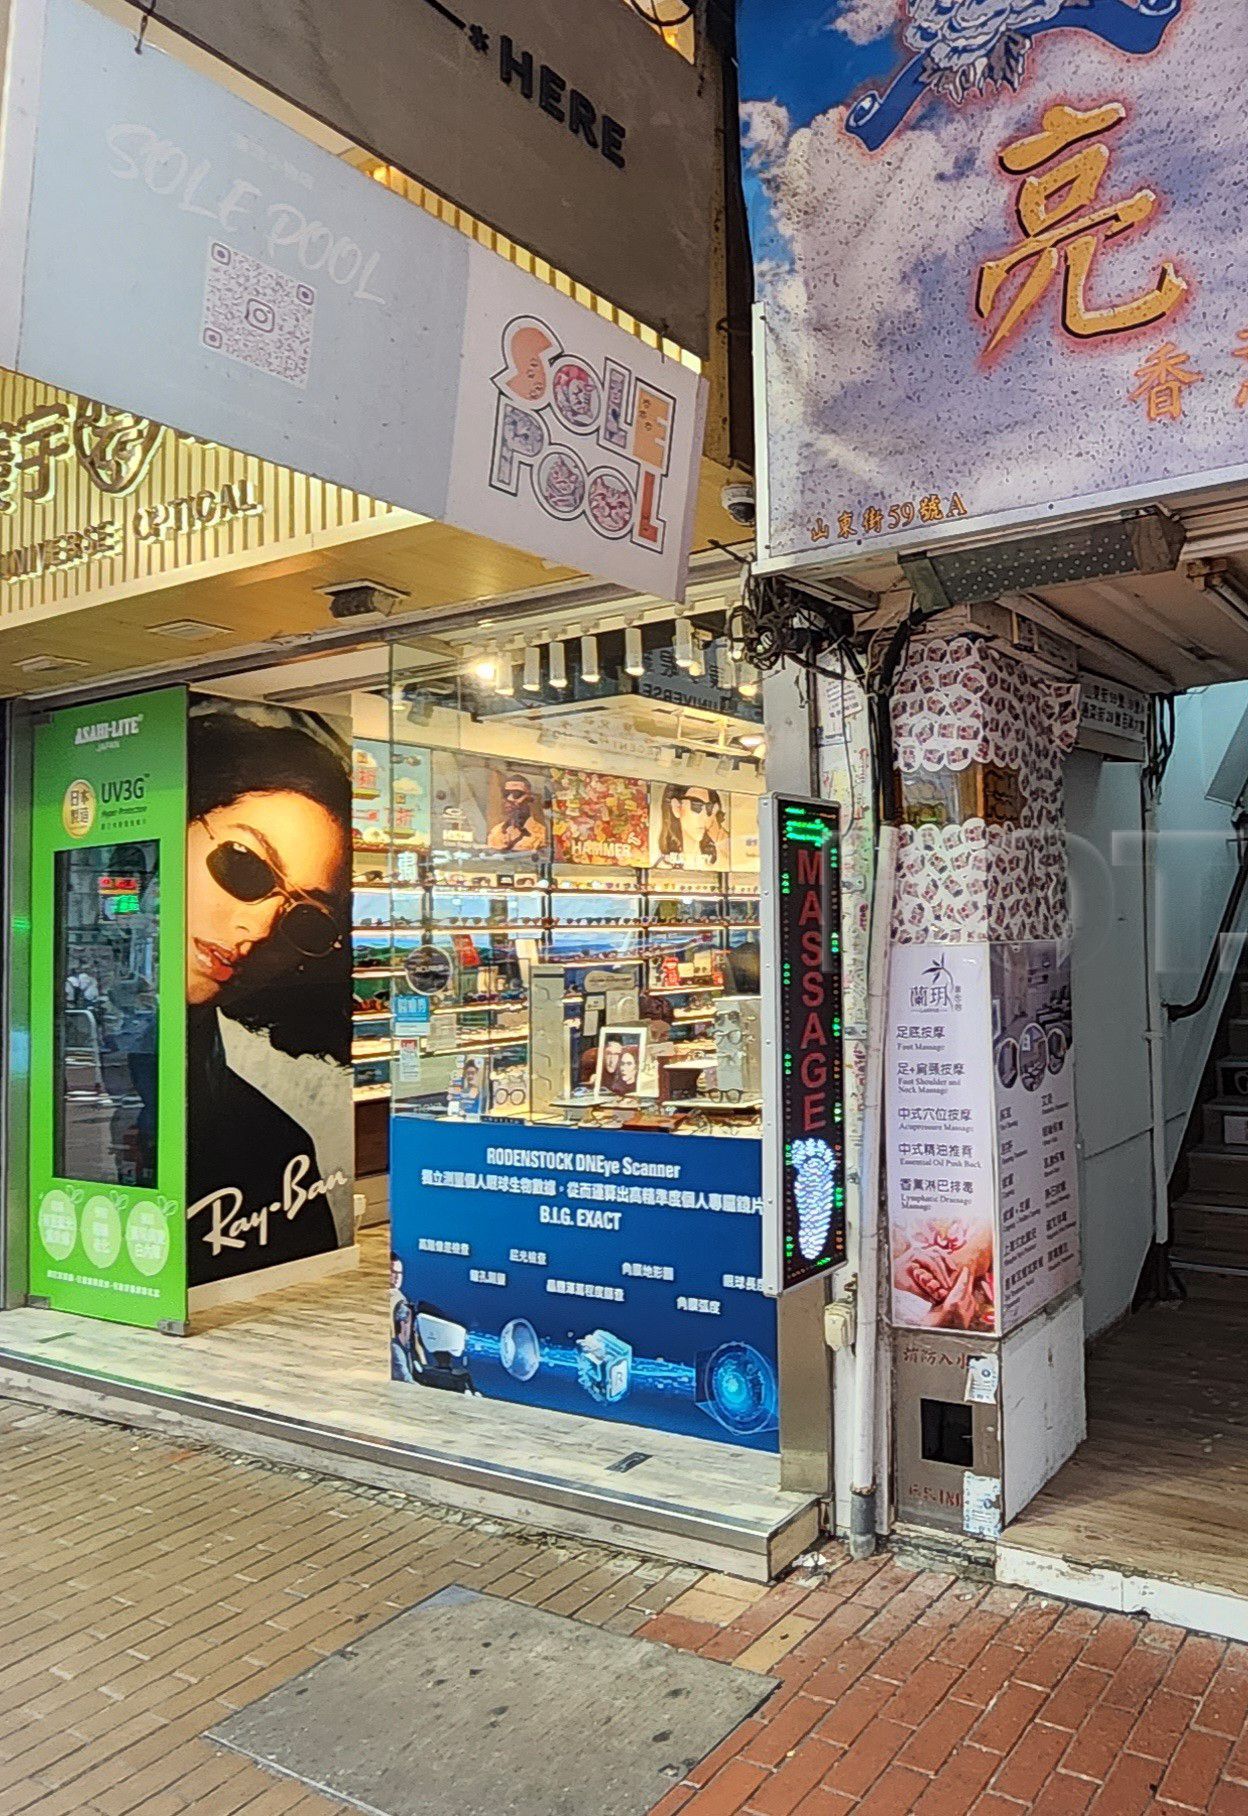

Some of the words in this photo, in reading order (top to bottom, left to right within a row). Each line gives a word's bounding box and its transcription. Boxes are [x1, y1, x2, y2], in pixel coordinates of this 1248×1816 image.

[499, 36, 628, 168] HERE
[107, 123, 262, 234] SOLE
[267, 203, 387, 305] POOL
[490, 314, 677, 478] SOLE
[133, 478, 261, 543] OPTICAL
[489, 393, 666, 554] POOL
[101, 777, 145, 804] UV3G
[797, 848, 826, 1132] MASSAGE
[486, 1147, 573, 1171] RODENSTOCK
[622, 1156, 681, 1178] Scanner
[540, 1205, 575, 1227] B.I.G.
[576, 1208, 622, 1231] EXACT
